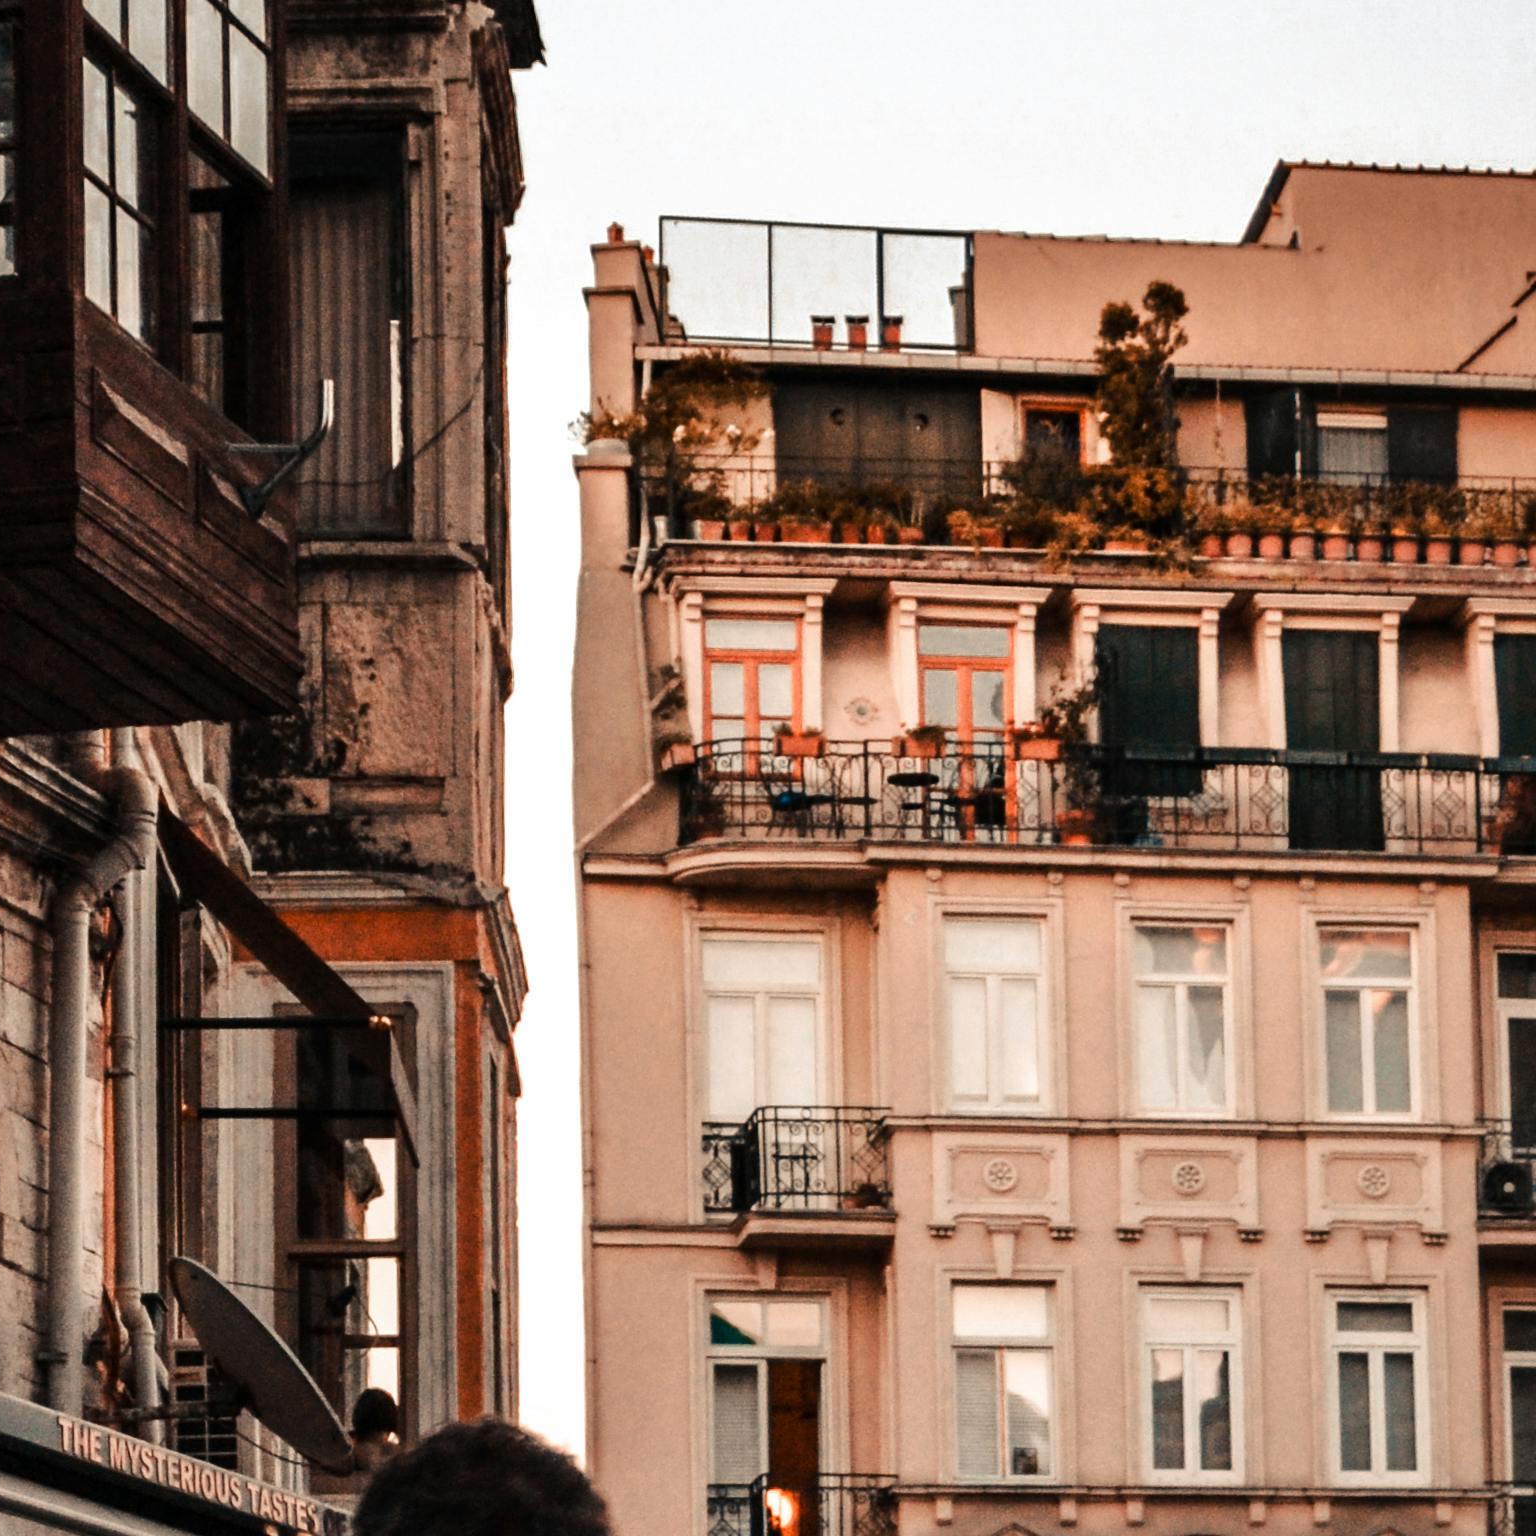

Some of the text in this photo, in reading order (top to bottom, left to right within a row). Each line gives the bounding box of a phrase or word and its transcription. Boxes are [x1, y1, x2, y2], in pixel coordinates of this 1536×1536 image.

[57, 1415, 102, 1463] THE
[109, 1434, 243, 1508] MYSTERIOUS
[247, 1483, 321, 1534] TASTES
